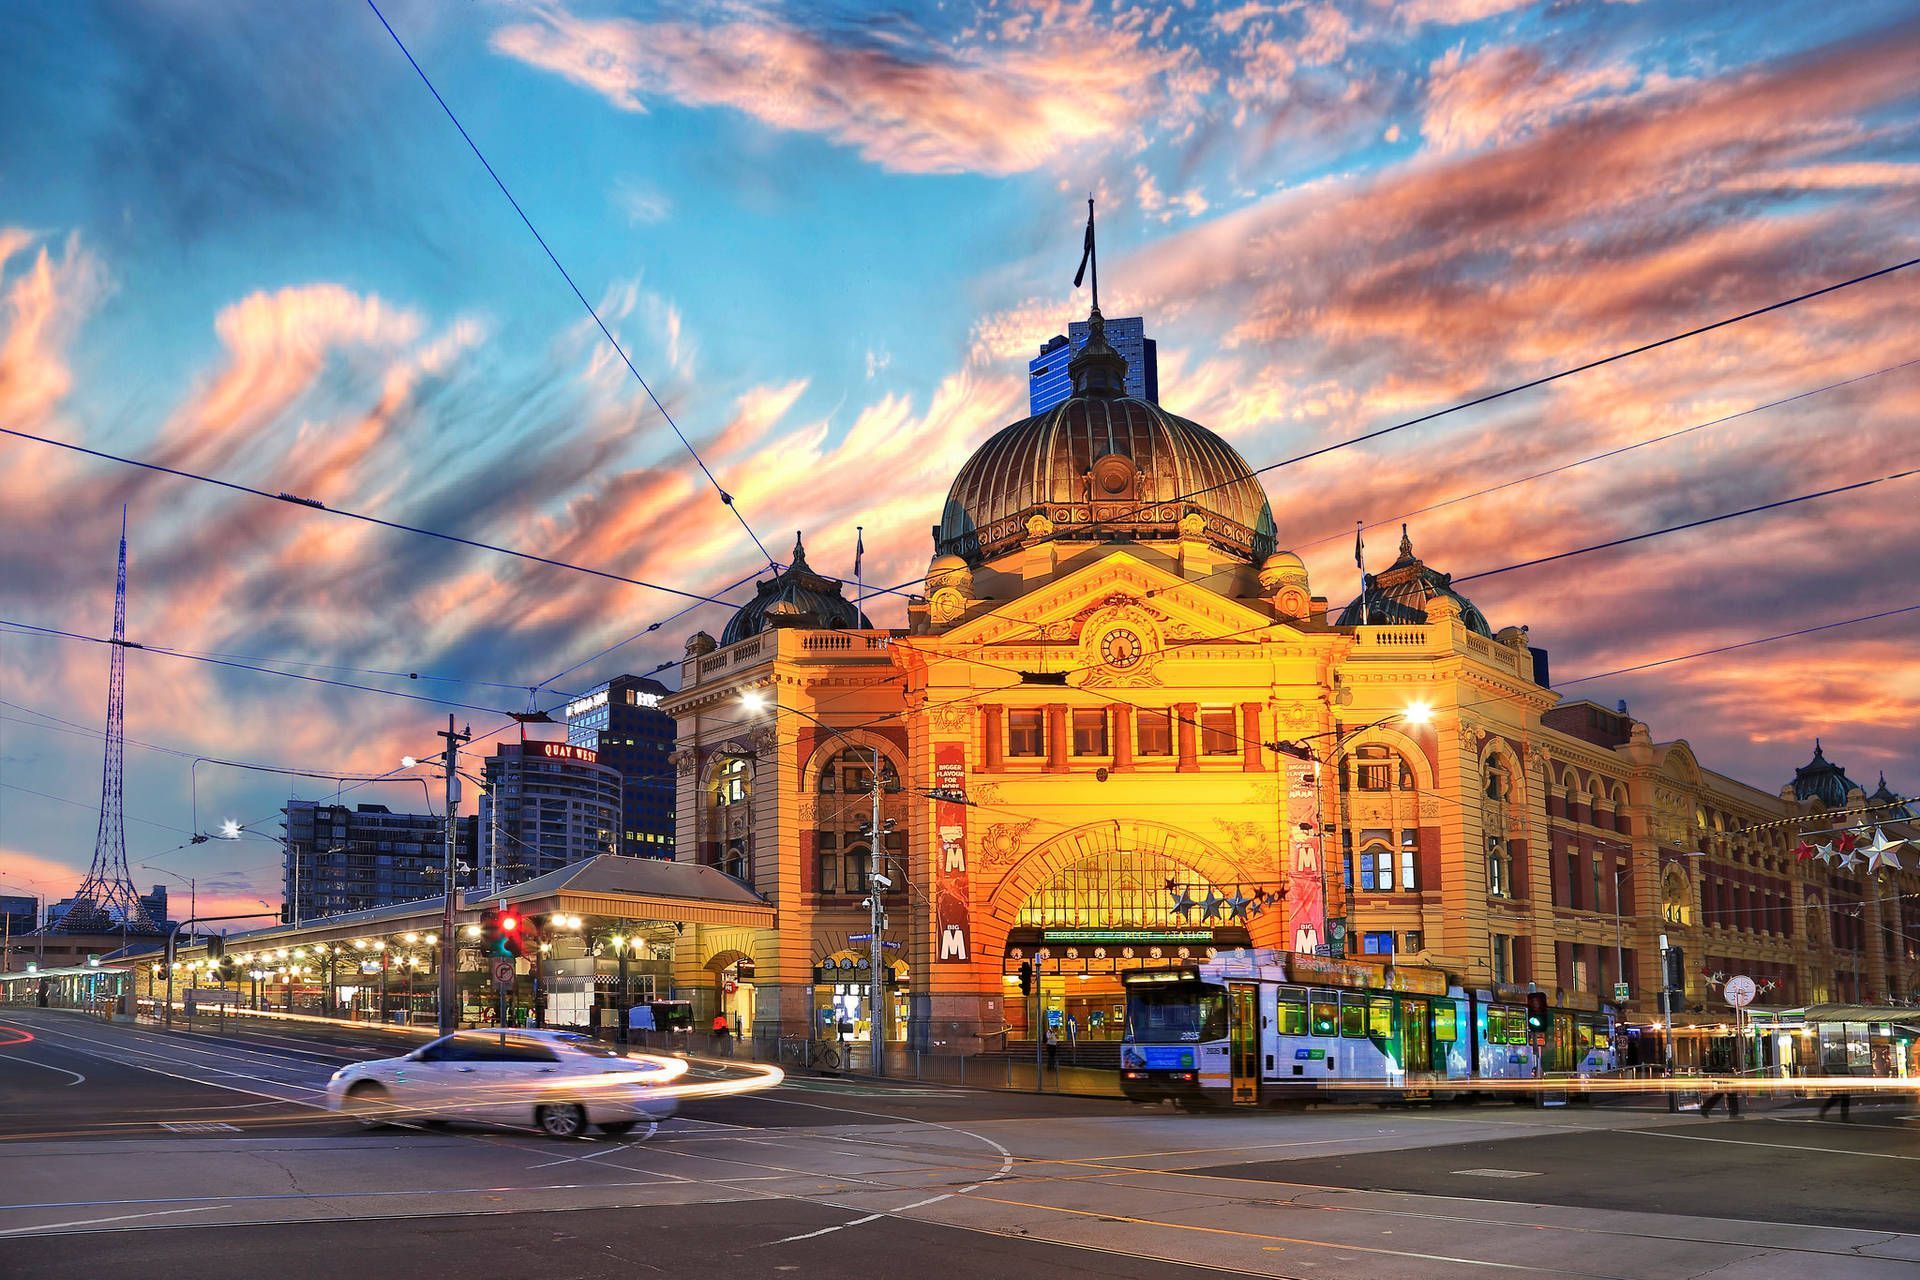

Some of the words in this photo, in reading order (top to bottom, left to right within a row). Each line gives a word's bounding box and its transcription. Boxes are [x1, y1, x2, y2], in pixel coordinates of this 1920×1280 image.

[545, 744, 573, 758] QUAY
[575, 748, 597, 763] WEST
[945, 848, 966, 872] M
[1297, 847, 1317, 872] M
[940, 929, 967, 960] M
[1295, 929, 1319, 955] M
